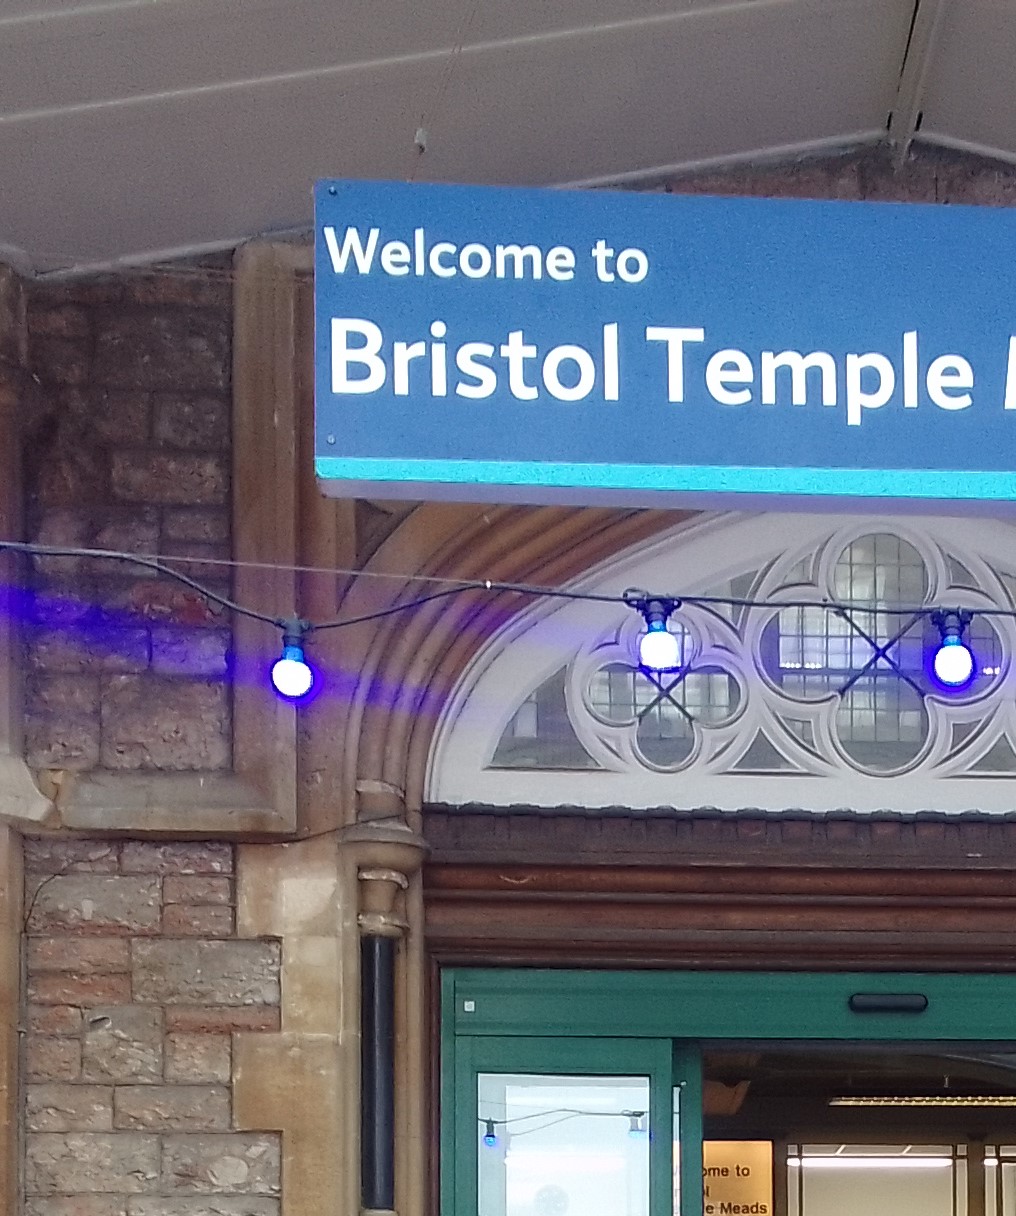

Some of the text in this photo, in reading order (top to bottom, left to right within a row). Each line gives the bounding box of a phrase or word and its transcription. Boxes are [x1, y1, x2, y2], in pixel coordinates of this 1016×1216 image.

[324, 227, 648, 282] Welcome to
[332, 318, 618, 401] Bristol
[646, 327, 973, 425] Temple
[736, 1165, 750, 1177] to
[720, 1203, 768, 1214] Meads
